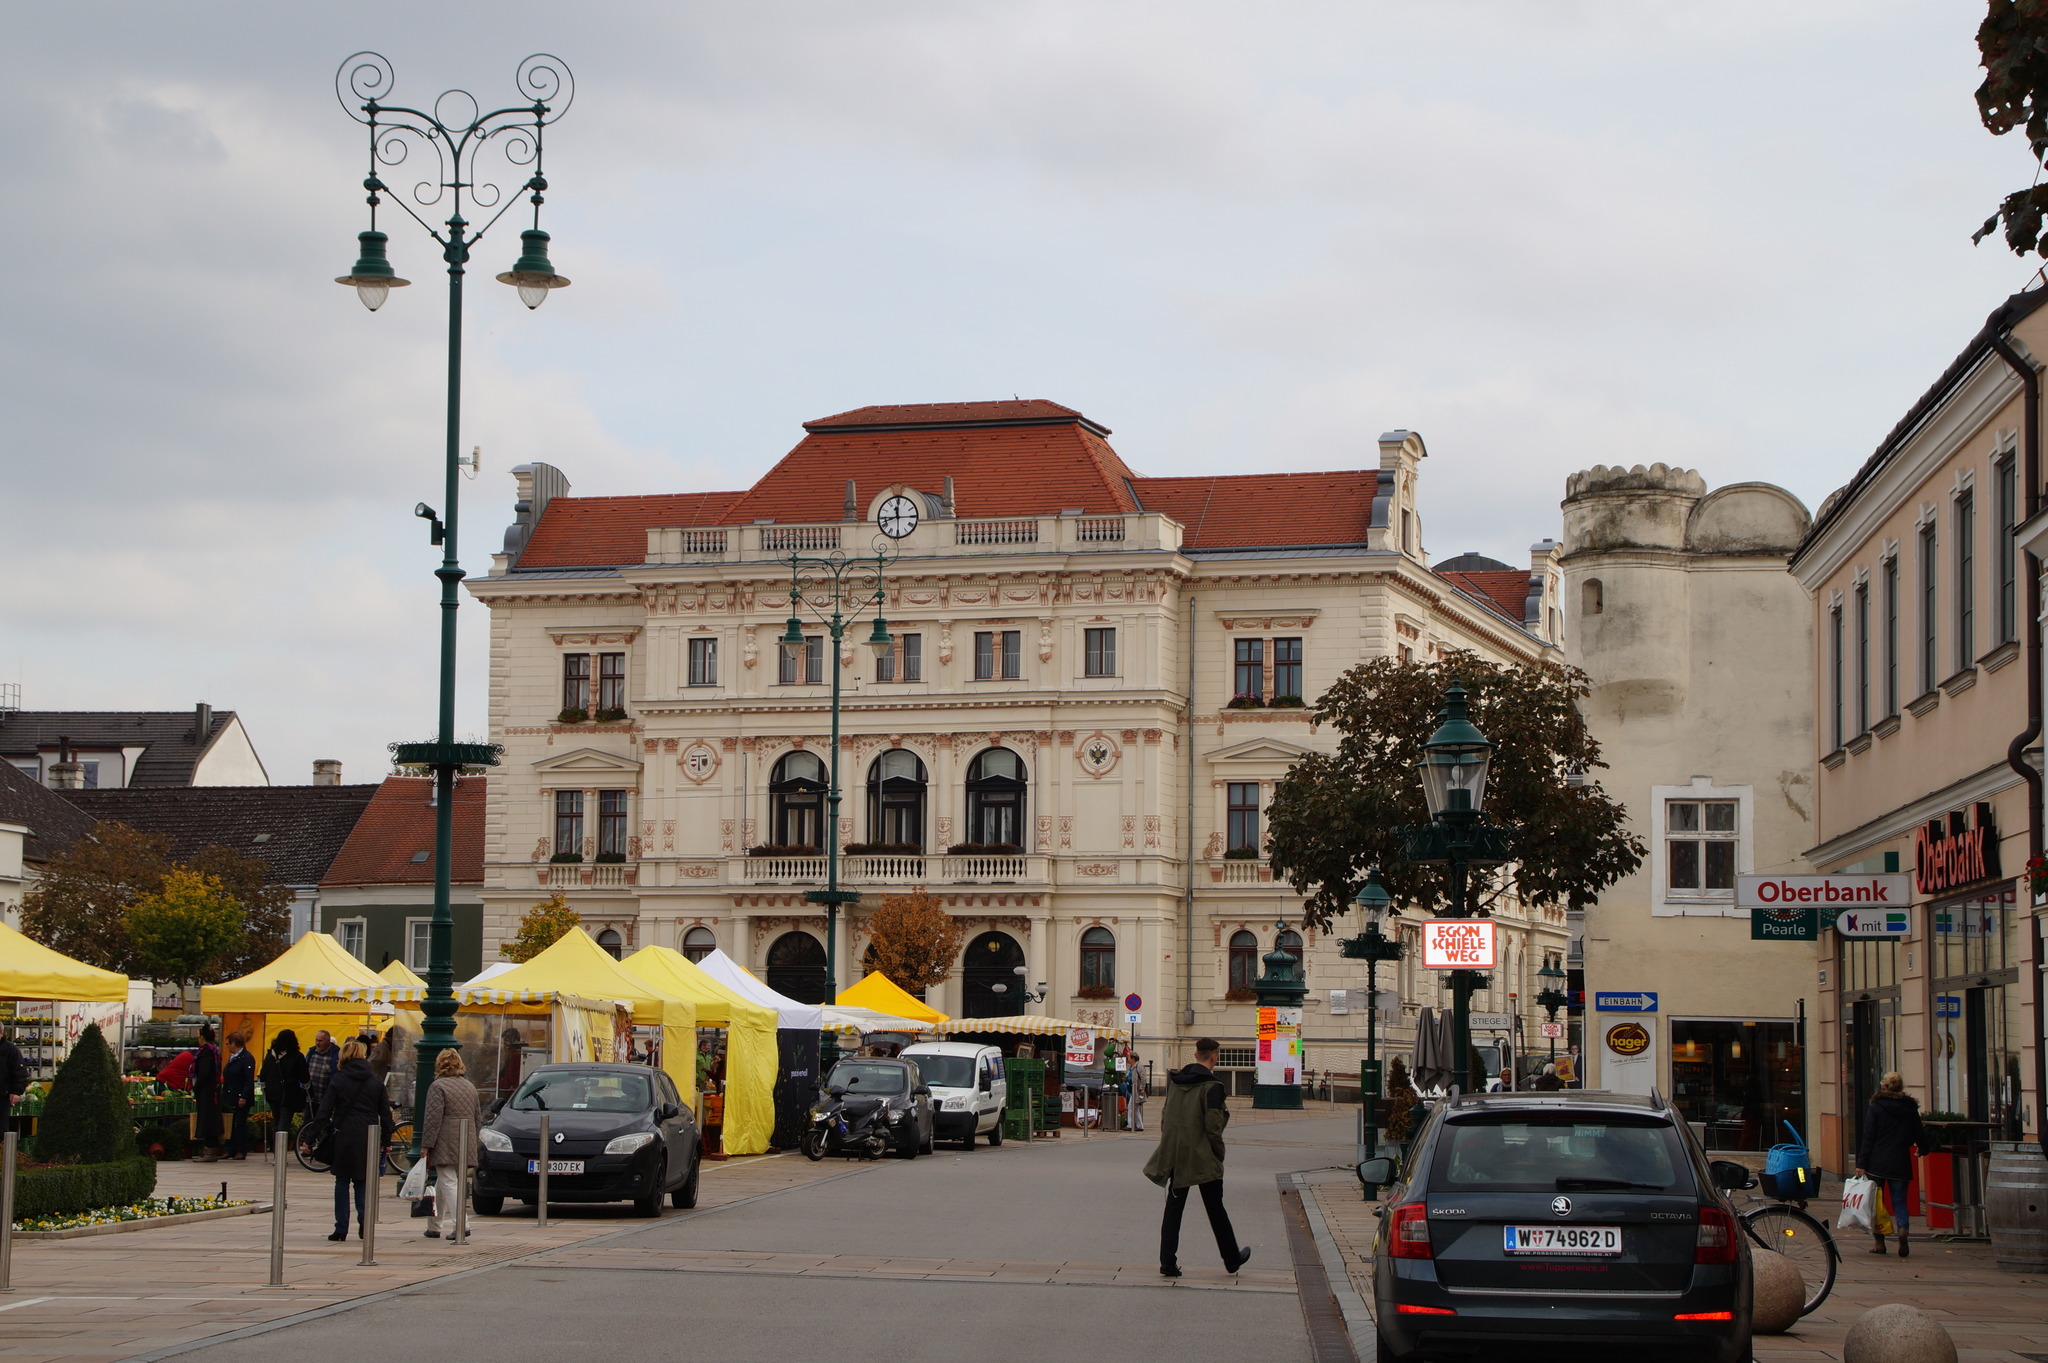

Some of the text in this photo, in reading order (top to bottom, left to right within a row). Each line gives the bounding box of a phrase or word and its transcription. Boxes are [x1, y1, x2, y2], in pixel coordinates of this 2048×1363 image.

[1915, 803, 1986, 894] Oberbank
[1757, 880, 1888, 902] Oberbank
[1437, 925, 1480, 938] EGON
[1763, 923, 1806, 935] Pearle
[1862, 921, 1881, 932] mit
[1432, 938, 1486, 950] SCHIELE
[1445, 950, 1479, 962] WEG
[1610, 1038, 1647, 1048] hager
[552, 1163, 568, 1171] 307
[570, 1163, 581, 1171] EK
[1432, 1207, 1466, 1216] ŠKODA
[1650, 1212, 1692, 1221] OCTAVIA
[1518, 1230, 1531, 1247] W
[1545, 1230, 1600, 1247] 74962
[1605, 1231, 1615, 1247] D
[1520, 1262, 1609, 1272] www.Tupperware.at
